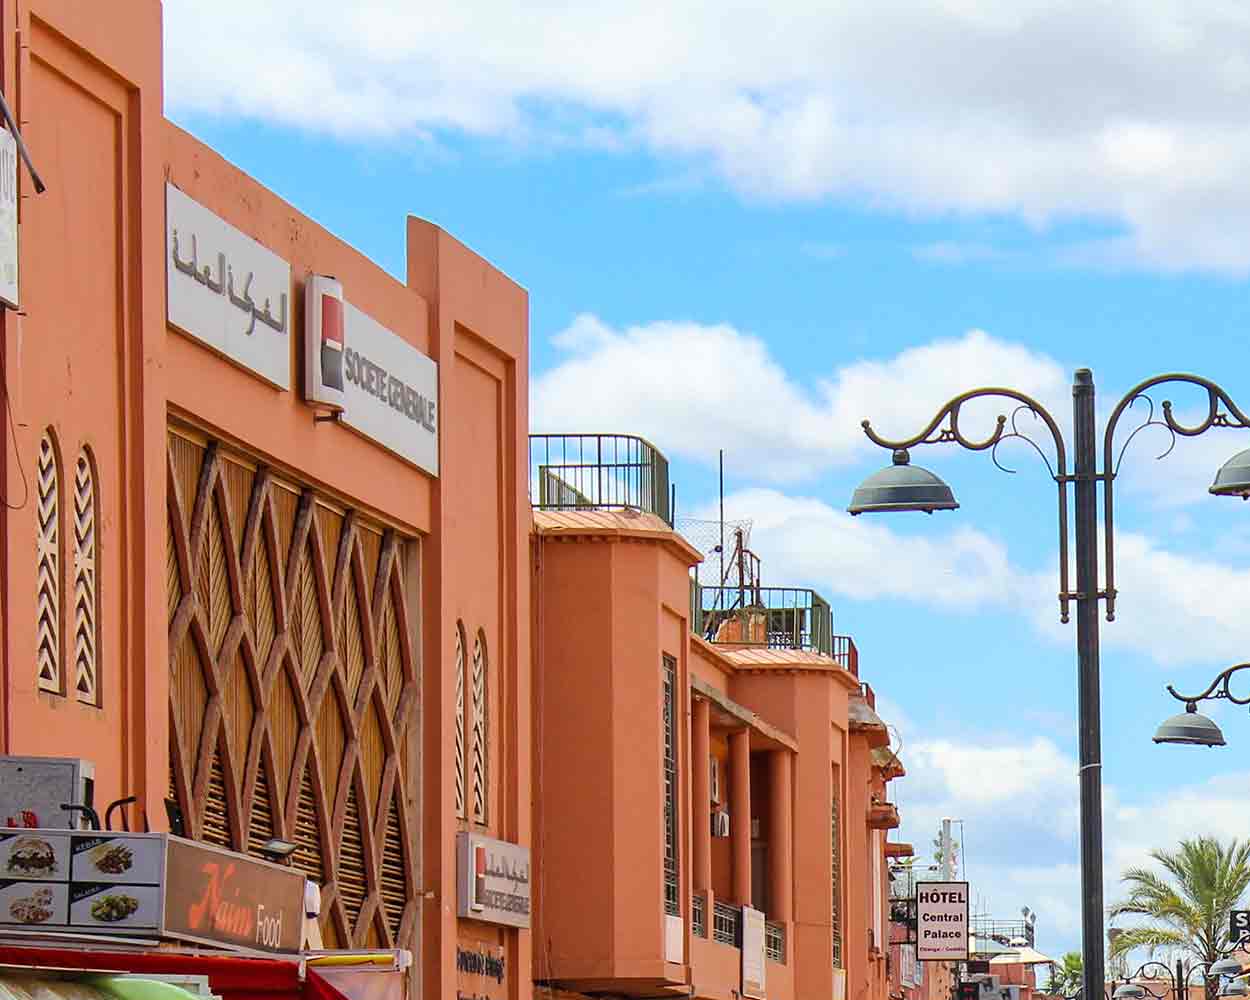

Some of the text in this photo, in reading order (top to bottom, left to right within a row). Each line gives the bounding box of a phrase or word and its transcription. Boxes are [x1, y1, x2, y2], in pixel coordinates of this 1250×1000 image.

[345, 346, 436, 433] SOCIETE GENERALE
[919, 888, 966, 904] HÔTEL
[922, 912, 963, 922] Central
[255, 903, 283, 949] Food
[923, 929, 962, 939] Palace
